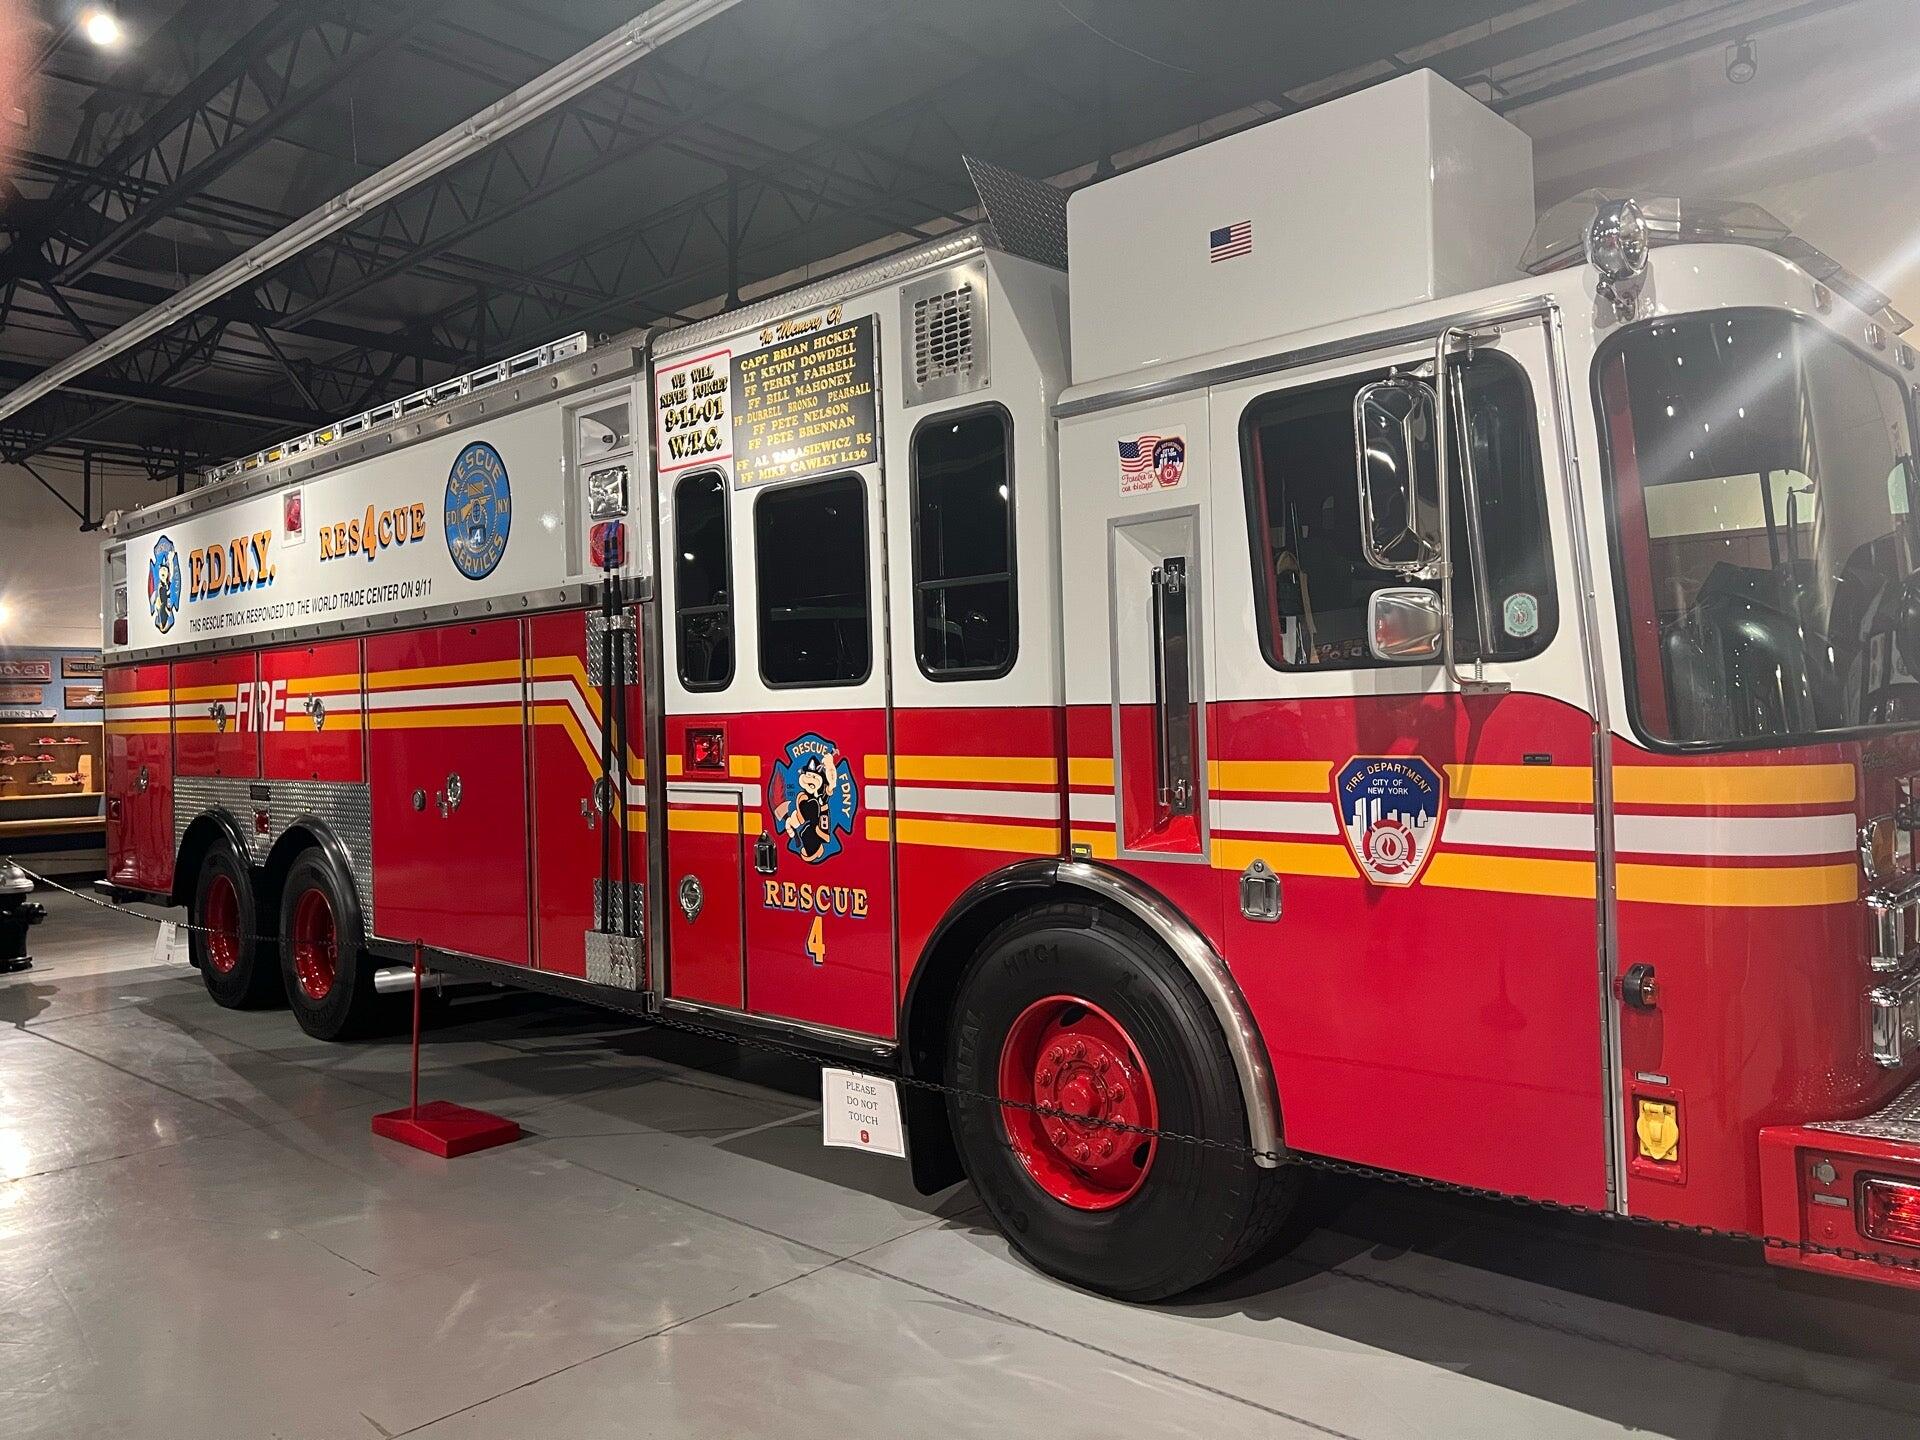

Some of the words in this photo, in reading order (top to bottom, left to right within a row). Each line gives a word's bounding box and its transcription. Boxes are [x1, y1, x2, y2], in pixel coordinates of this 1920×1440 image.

[776, 315, 822, 340] Memory
[740, 354, 769, 371] CAPT
[773, 342, 808, 361] BRIAN
[813, 326, 858, 350] HICKEY
[743, 372, 756, 384] LT
[761, 360, 795, 379] KEVIN
[800, 342, 856, 368] DOWDELL
[660, 388, 688, 409] NEVER
[692, 376, 728, 400] FORGET
[744, 384, 757, 398] FF
[762, 372, 798, 392] TERRY
[804, 357, 856, 381] FARRELL
[748, 397, 761, 410] FF
[766, 389, 789, 405] BILL
[795, 372, 852, 397] MAHONEY
[734, 415, 743, 427] FF
[747, 405, 782, 424] DURRELL
[788, 396, 818, 413] BRONKO
[827, 382, 871, 402] PEARSALL
[753, 423, 766, 436] FF
[772, 415, 798, 430] PETE
[804, 402, 849, 423] NELSON
[748, 438, 762, 450] FF
[767, 430, 794, 446] PETE
[799, 415, 856, 438] BRENNAN
[450, 447, 503, 496] RESCUE
[736, 459, 749, 470] FF
[755, 454, 769, 468] AL
[741, 472, 753, 483] FF
[759, 464, 787, 480] MIKE
[790, 453, 839, 473] CAWLEY
[474, 528, 481, 542] 4
[188, 530, 276, 602] F.D.N.Y.
[452, 533, 504, 573] SERVICES
[189, 617, 201, 632] THIS
[202, 614, 225, 631] RESCUE
[226, 611, 245, 627] TRUCK
[246, 604, 284, 624] RESPONDED
[286, 602, 295, 617] TO
[297, 597, 310, 615] THE
[312, 594, 338, 613] WORLD
[340, 589, 364, 608] TRADE
[366, 583, 398, 605] CENTER
[400, 580, 413, 599] ON
[415, 578, 432, 597] 9/11
[236, 679, 287, 733] FIRE
[792, 741, 828, 758] RESCUE
[839, 773, 852, 818] FDNY
[1345, 771, 1365, 793] FIRE
[1366, 762, 1432, 794] DEPARTMENT
[1387, 787, 1409, 795] YORK
[764, 880, 868, 918] RESCUE
[806, 915, 825, 967] 4
[846, 1081, 876, 1096] PLEASE
[846, 1095, 858, 1106] DO
[860, 1097, 878, 1111] NOT
[848, 1110, 879, 1126] TOUCH
